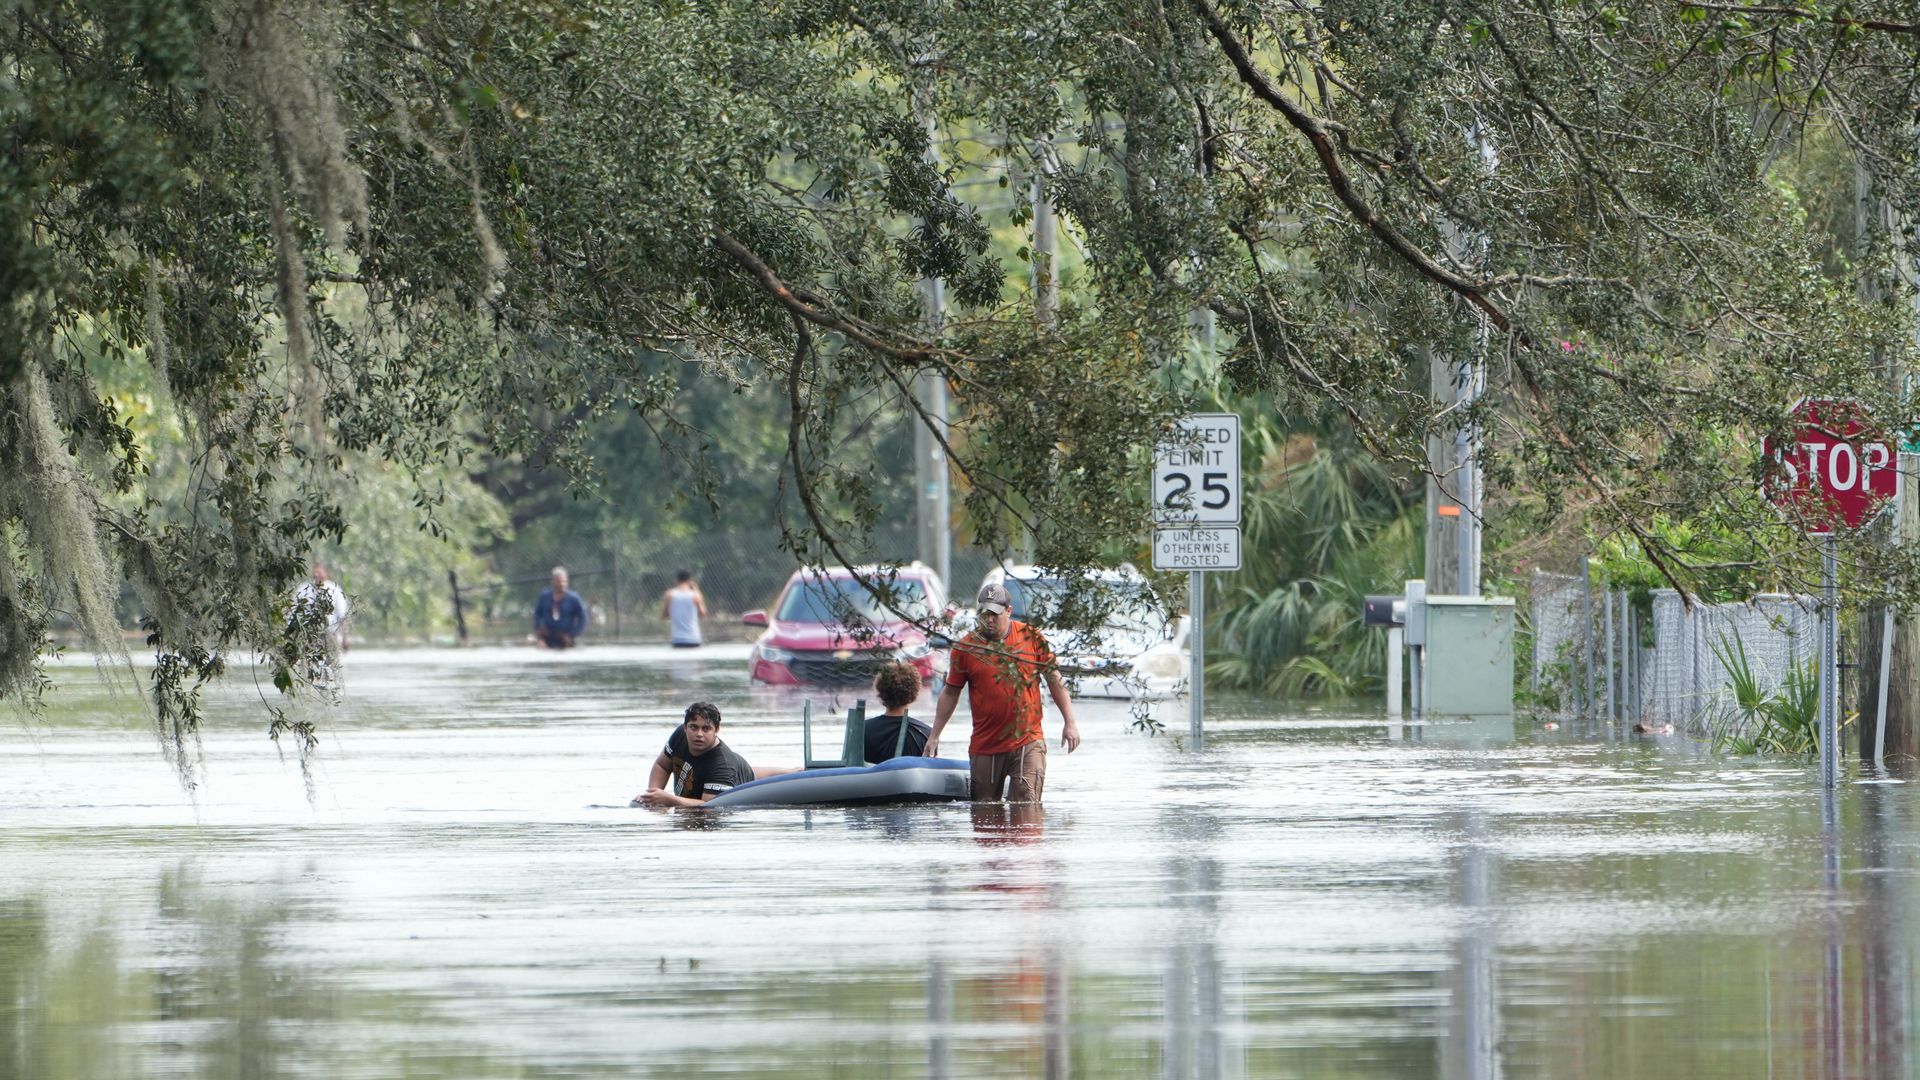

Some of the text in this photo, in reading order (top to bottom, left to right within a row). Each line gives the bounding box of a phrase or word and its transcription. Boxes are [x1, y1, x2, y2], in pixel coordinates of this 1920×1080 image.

[1162, 428, 1231, 444] PEED
[1169, 450, 1224, 466] LIMIT
[1774, 442, 1889, 491] STOP
[1163, 472, 1231, 510] 25
[1173, 531, 1220, 542] UNLESS
[1162, 543, 1231, 554] OTHERWISE
[1173, 555, 1220, 566] POSTED
